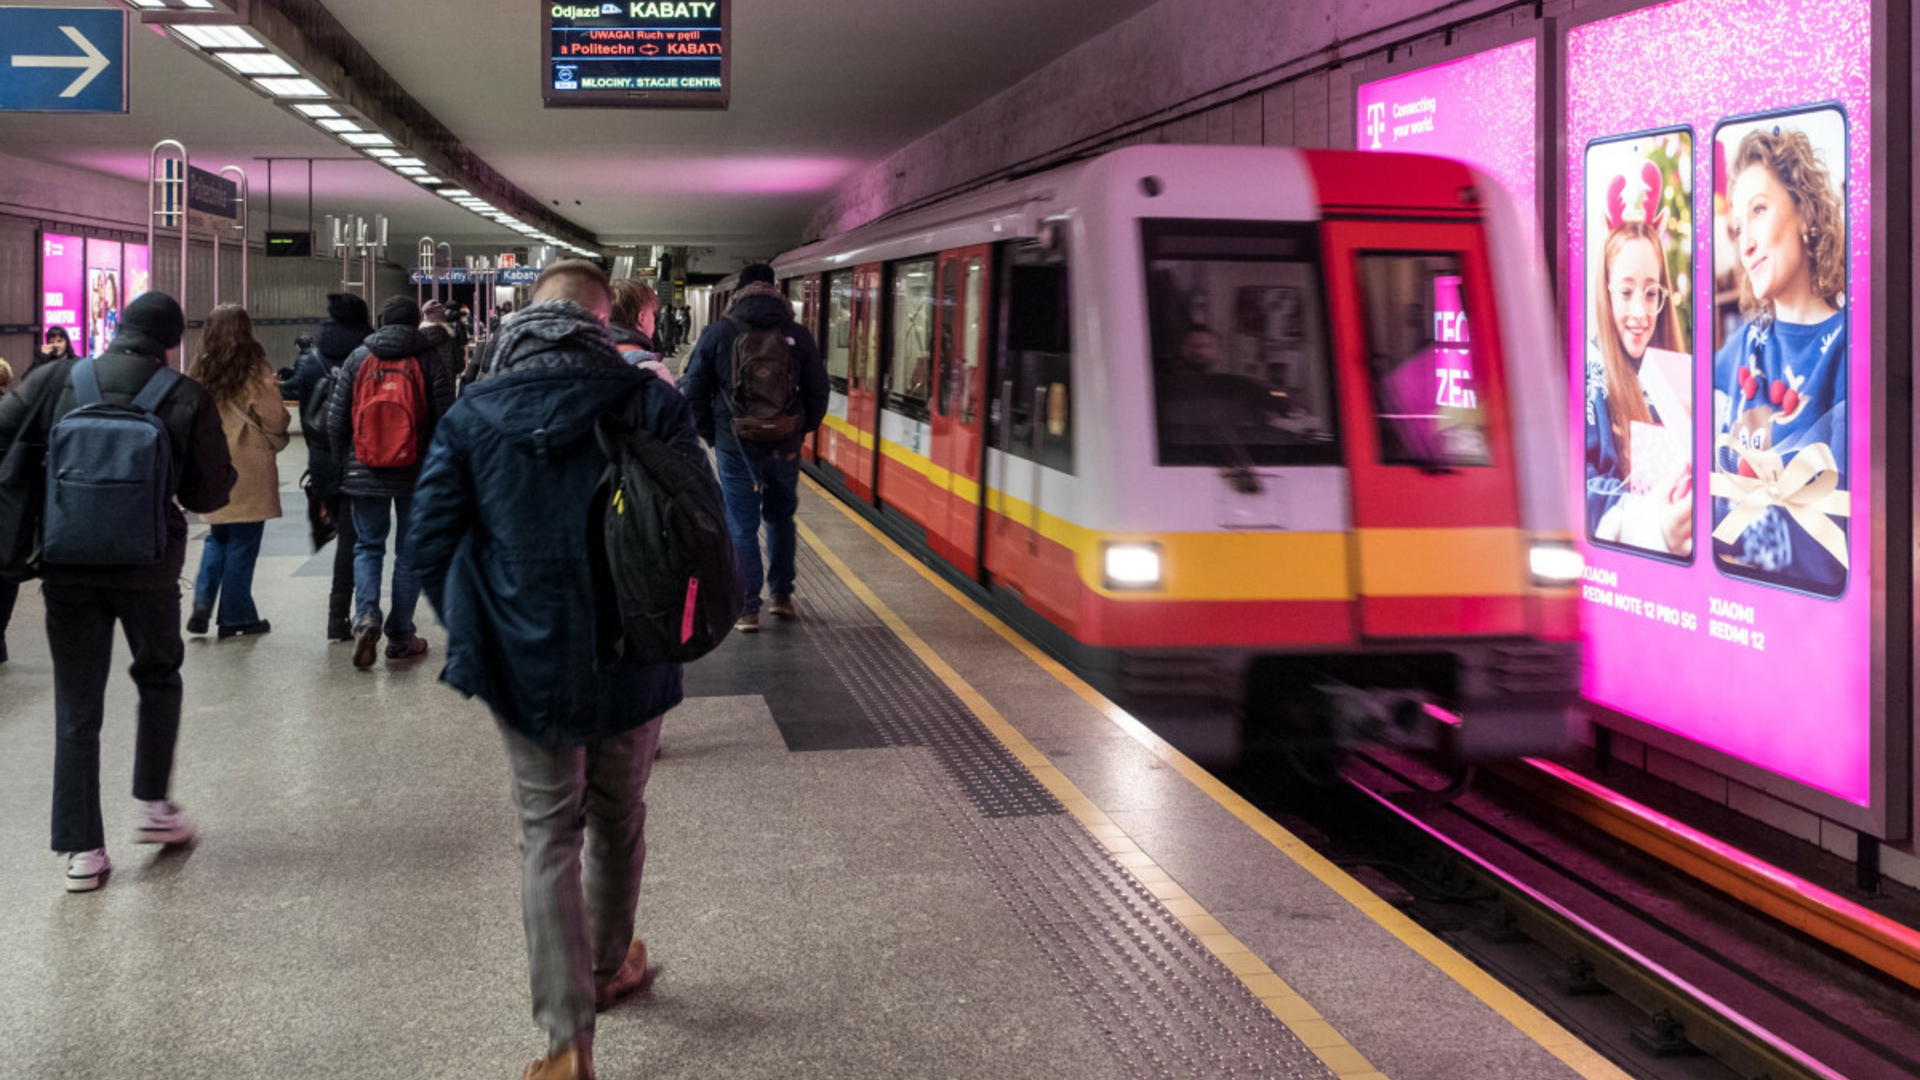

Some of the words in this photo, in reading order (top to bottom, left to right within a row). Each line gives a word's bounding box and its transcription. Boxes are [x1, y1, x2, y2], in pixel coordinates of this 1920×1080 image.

[552, 6, 600, 20] Odjazd
[630, 2, 716, 18] KABATY
[590, 31, 634, 40] UWAGA!
[637, 31, 663, 40] Ruch
[571, 43, 635, 54] Politechn
[636, 77, 678, 88] STACJE
[1393, 97, 1437, 119] Connecting
[1393, 122, 1410, 142] your
[503, 270, 540, 282] Kabaty
[1582, 564, 1618, 588] XIAOMI
[1582, 584, 1613, 607] REDMI
[1615, 592, 1642, 615] NOTE
[1643, 601, 1655, 619] 12
[1656, 604, 1680, 626] PRO
[1681, 611, 1697, 631] 5G
[1709, 596, 1754, 625] XIAOMI
[1709, 619, 1749, 647] REDMI
[1750, 632, 1765, 651] 12
